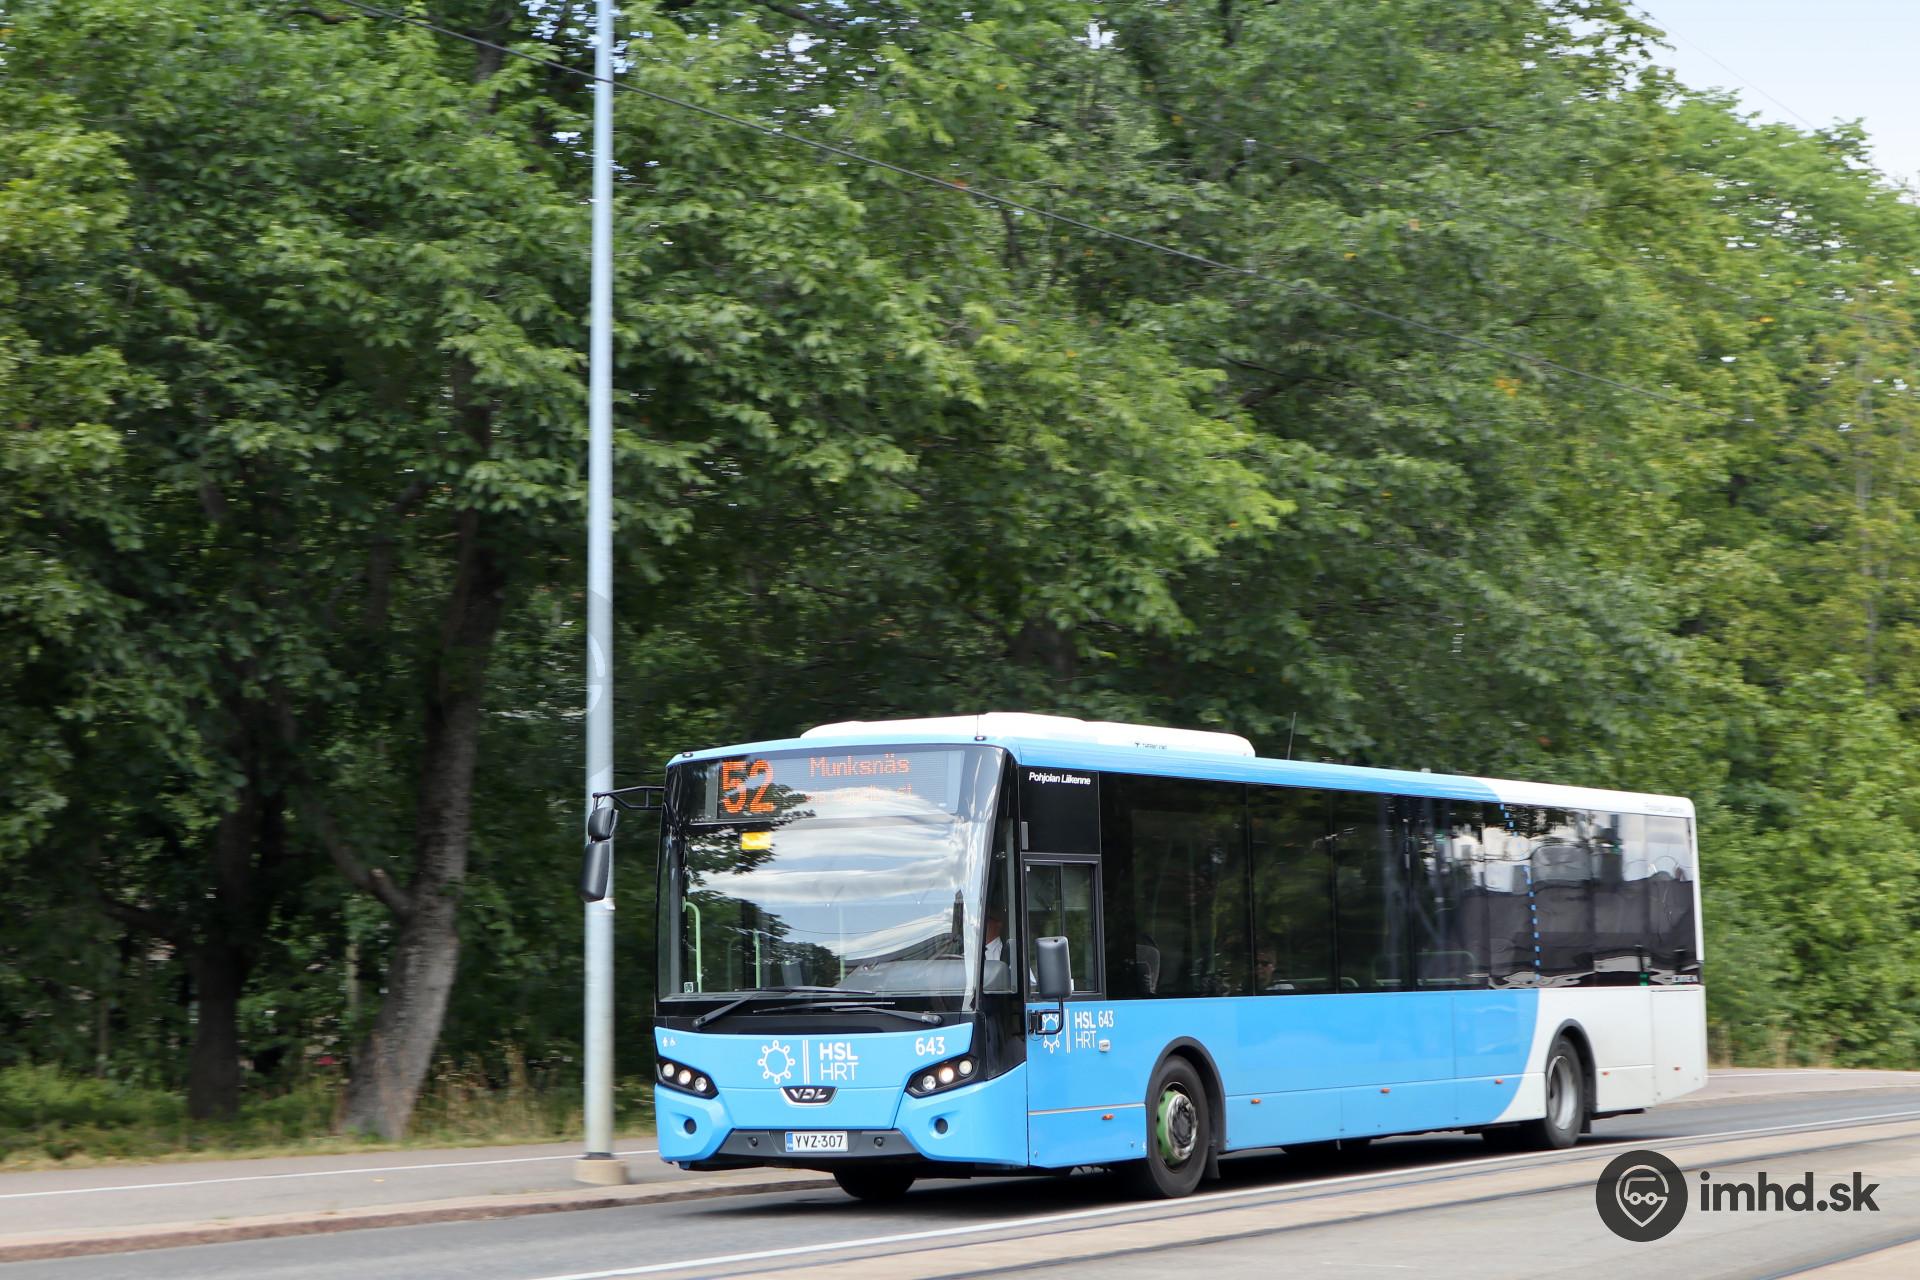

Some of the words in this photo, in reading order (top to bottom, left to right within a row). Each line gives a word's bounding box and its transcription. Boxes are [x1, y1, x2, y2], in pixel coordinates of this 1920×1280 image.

[808, 753, 910, 777] Munksnäs
[721, 760, 775, 813] 52
[1029, 771, 1061, 784] Pohjolan
[1061, 774, 1091, 785] Liikenne
[1074, 1011, 1096, 1029] HSL
[1098, 1010, 1114, 1028] 643
[915, 1036, 945, 1056] 643
[1075, 1030, 1097, 1048] HRT
[819, 1042, 859, 1061] HSL
[820, 1062, 859, 1081] HRT
[789, 1088, 827, 1100] VDL
